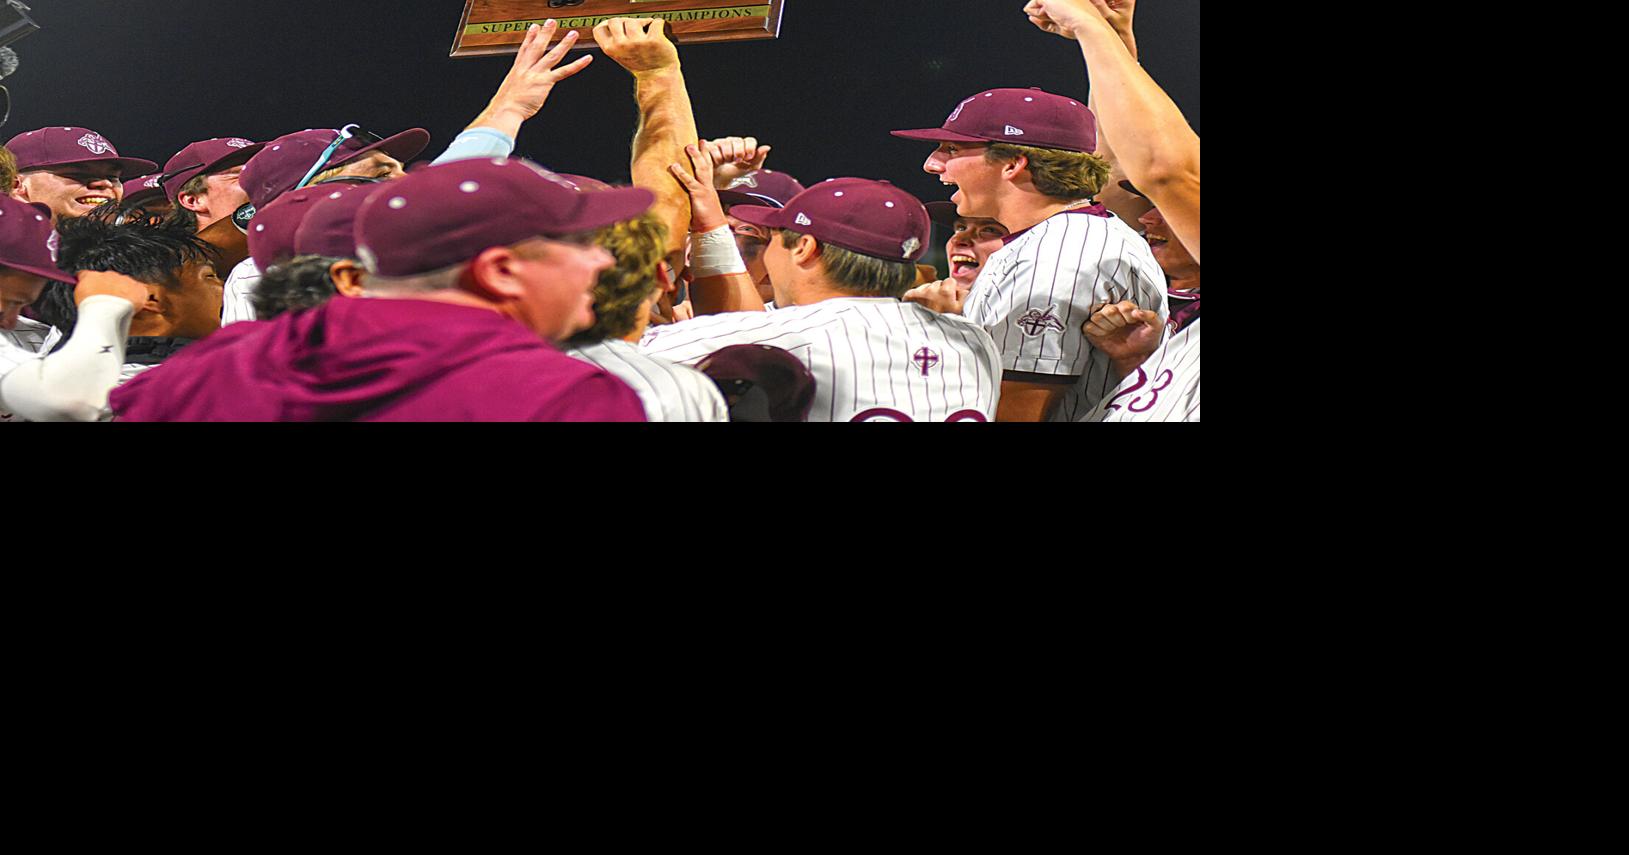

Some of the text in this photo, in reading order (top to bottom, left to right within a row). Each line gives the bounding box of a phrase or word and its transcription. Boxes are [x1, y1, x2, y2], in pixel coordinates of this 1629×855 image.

[481, 8, 752, 33] SUPER ECTIO CHAMPIONS
[1104, 366, 1173, 413] 23
